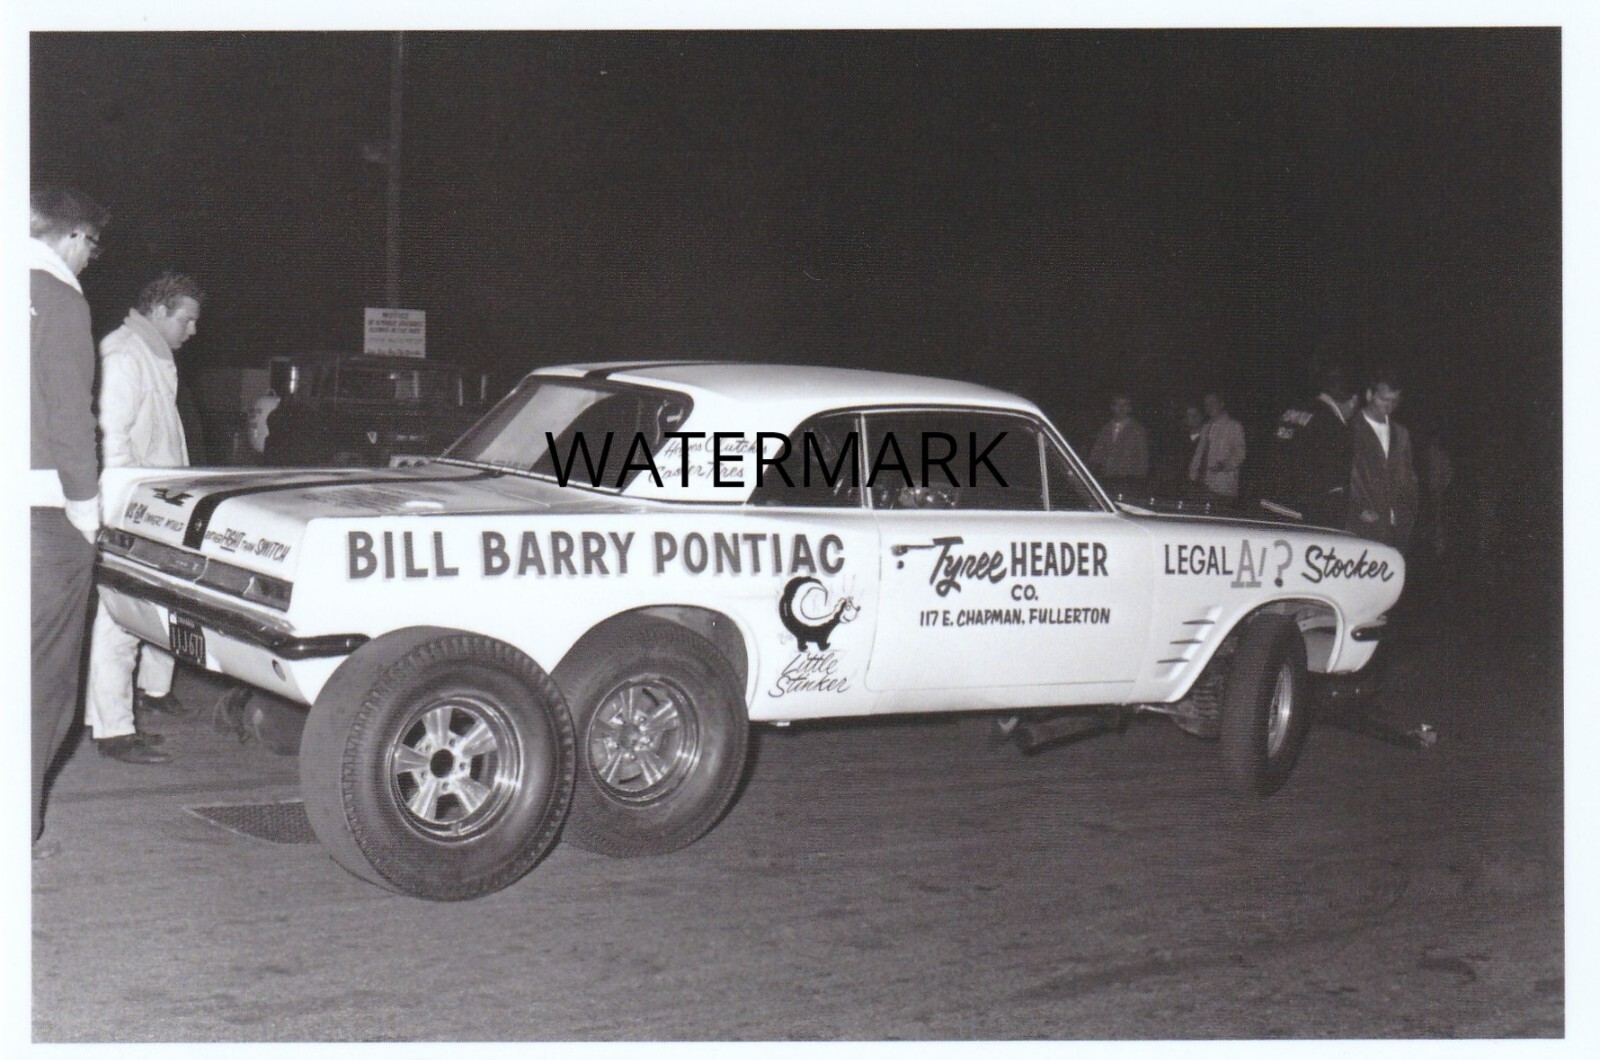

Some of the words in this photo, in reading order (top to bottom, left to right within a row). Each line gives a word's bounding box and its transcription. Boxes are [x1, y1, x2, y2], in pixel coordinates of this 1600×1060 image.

[254, 538, 290, 562] SWITCH
[346, 531, 460, 580] BILL
[478, 531, 636, 577] BARRY
[653, 531, 845, 576] PONTIAC
[929, 536, 1007, 597] Tyree
[1010, 541, 1109, 577] HEADER
[1164, 544, 1233, 576] LEGAL
[1301, 544, 1395, 583] Stocker
[1010, 584, 1039, 601] CO.
[919, 610, 939, 627] 117
[942, 609, 954, 627] E.
[1029, 607, 1111, 625] FULLERTON
[781, 652, 838, 675] Little
[768, 674, 851, 698] Stinker
